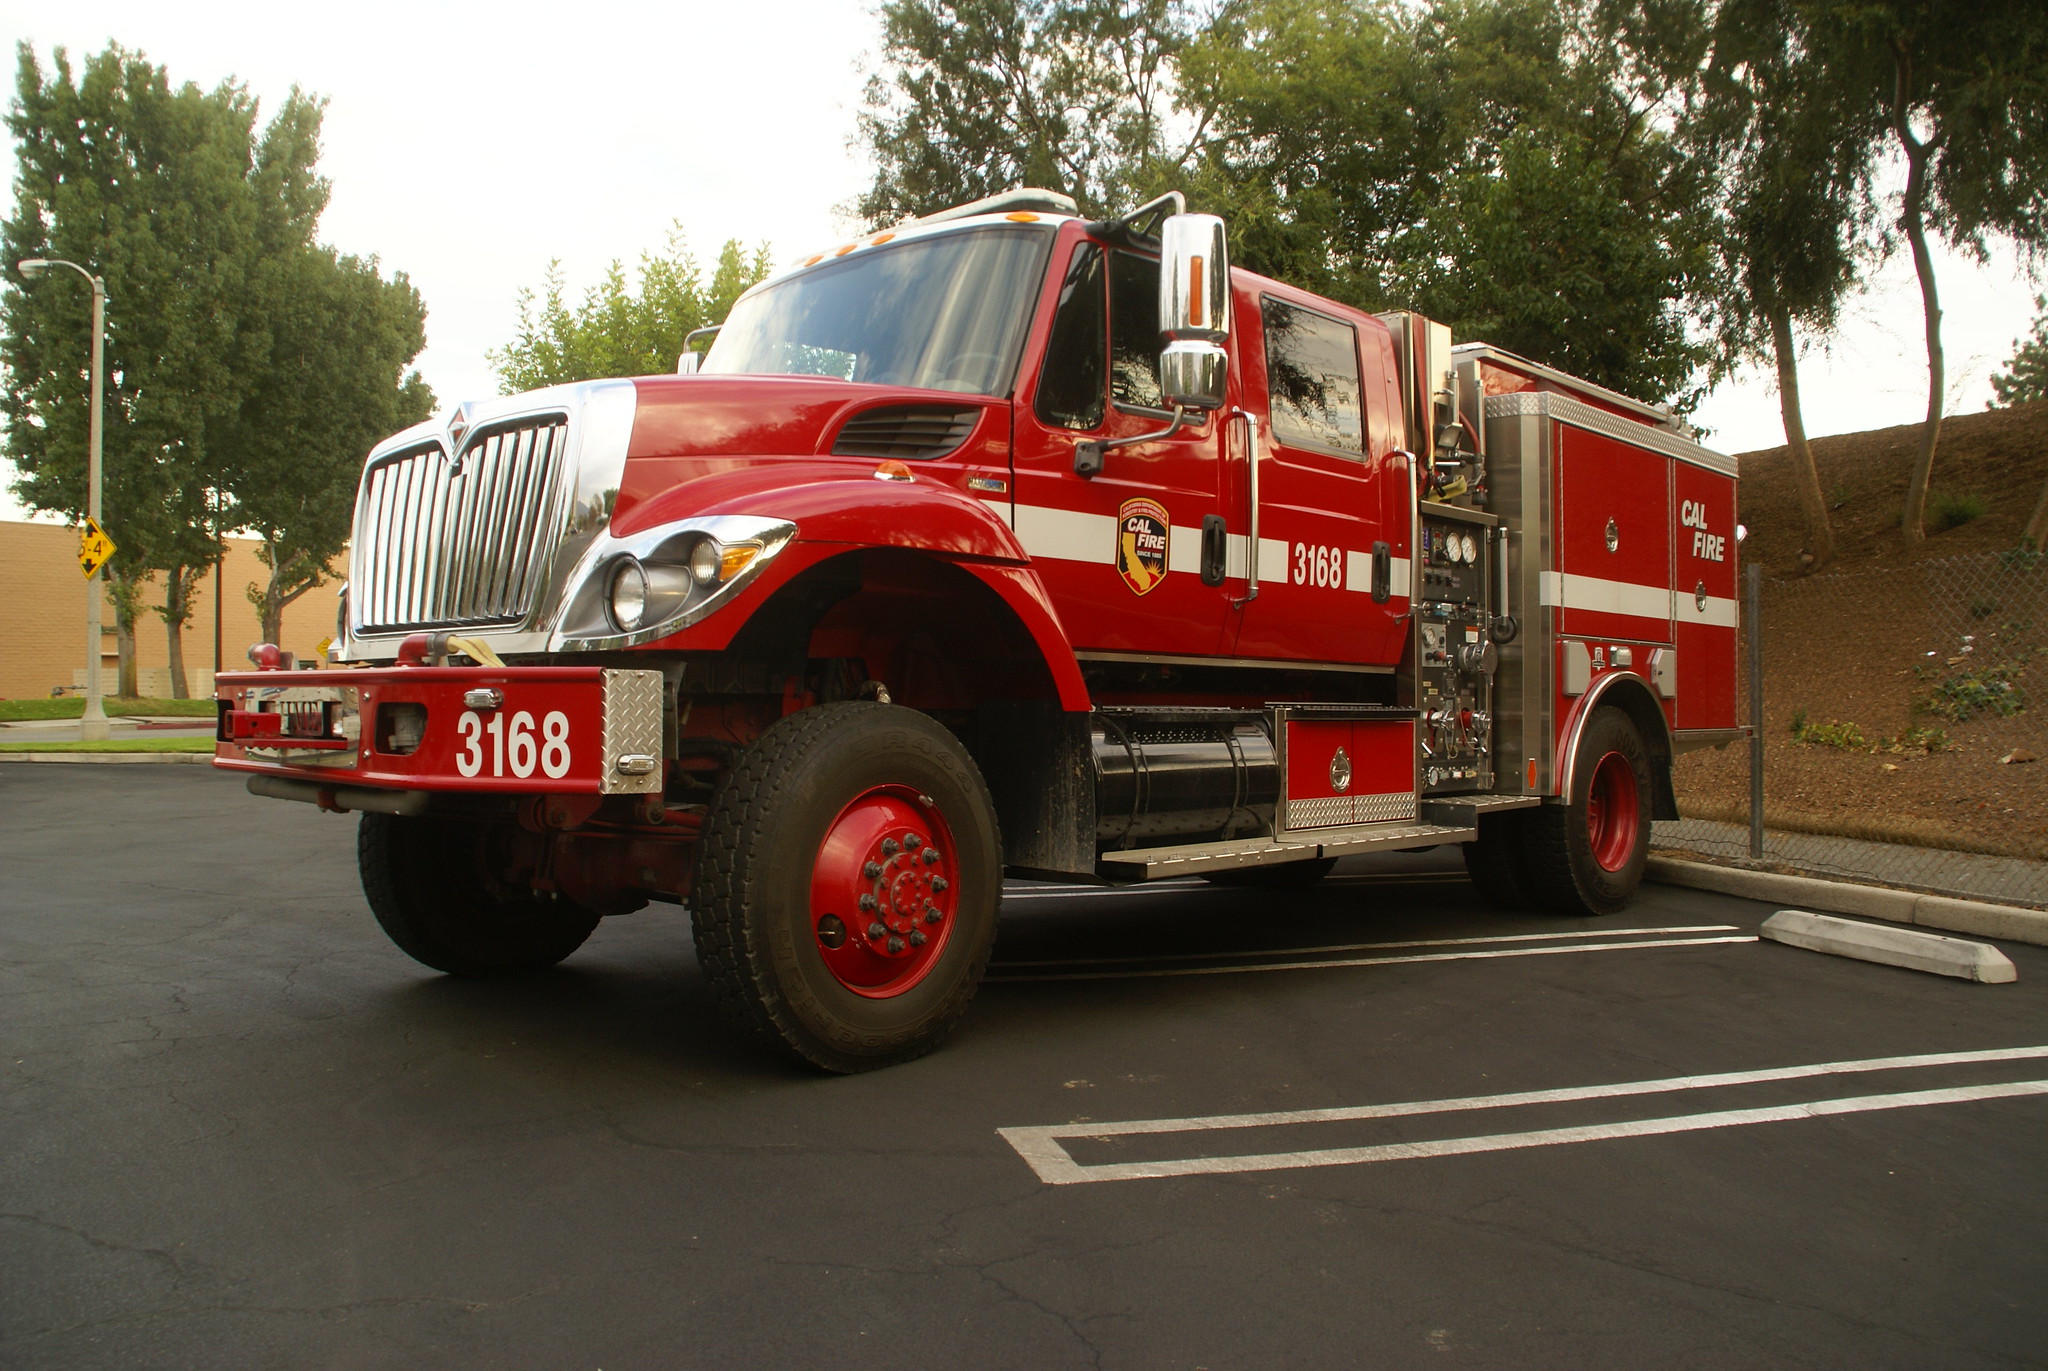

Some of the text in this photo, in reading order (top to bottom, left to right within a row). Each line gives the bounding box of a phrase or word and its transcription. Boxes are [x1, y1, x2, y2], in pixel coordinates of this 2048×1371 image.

[1128, 518, 1151, 534] CAL
[1682, 500, 1708, 530] CAL
[1136, 550, 1151, 558] SINCE
[1137, 533, 1165, 549] FIRE
[1692, 531, 1725, 562] FIRE
[1294, 542, 1342, 589] 3168
[456, 710, 571, 779] 3168
[770, 928, 962, 1048] Goodrich
